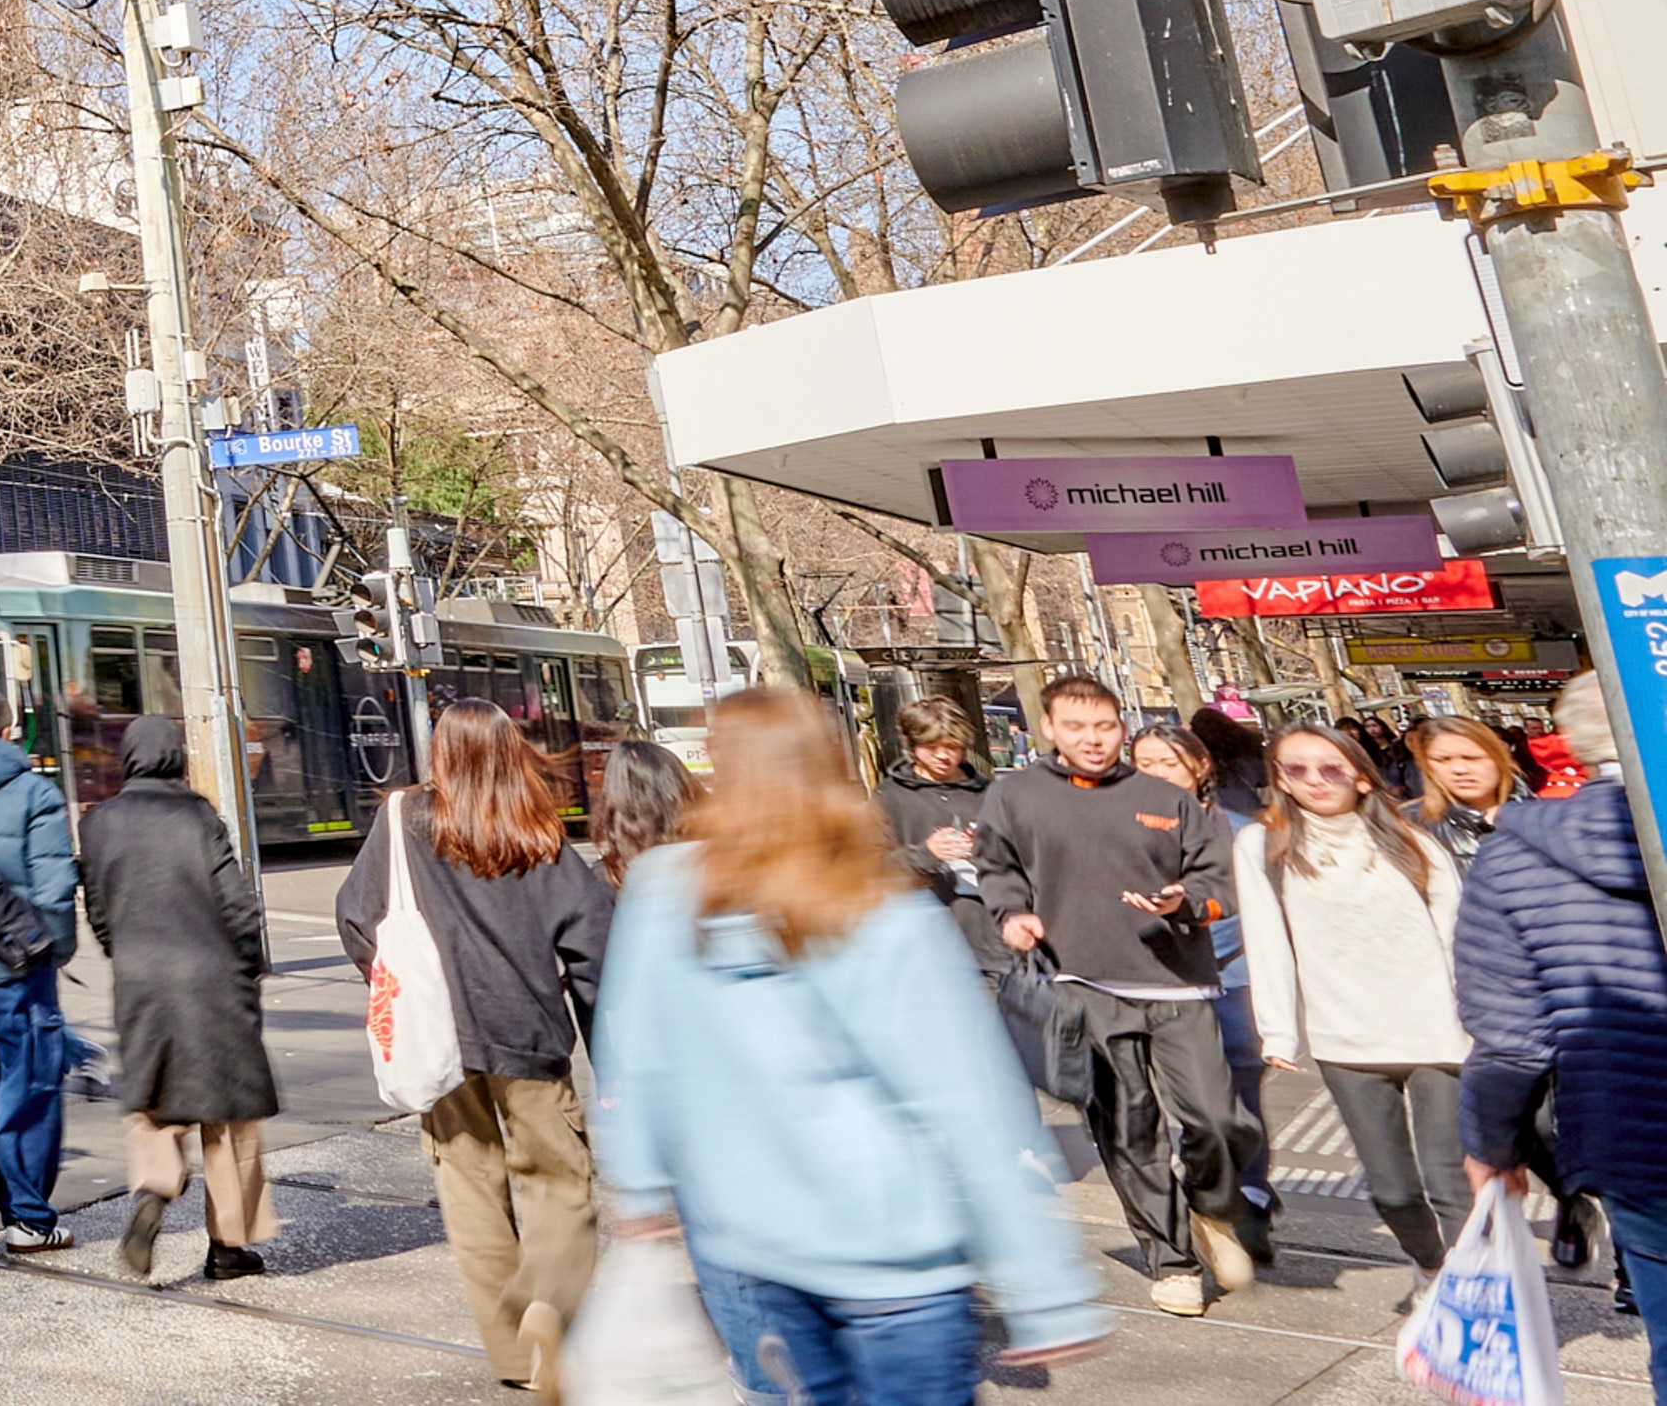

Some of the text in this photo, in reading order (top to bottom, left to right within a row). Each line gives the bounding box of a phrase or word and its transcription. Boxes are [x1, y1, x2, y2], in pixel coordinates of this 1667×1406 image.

[258, 428, 351, 454] Bourke St
[297, 448, 318, 459] 271
[1067, 482, 1227, 504] michael hill
[1199, 538, 1358, 562] michael hill
[1348, 596, 1441, 607] PASTA PIZZA BAR
